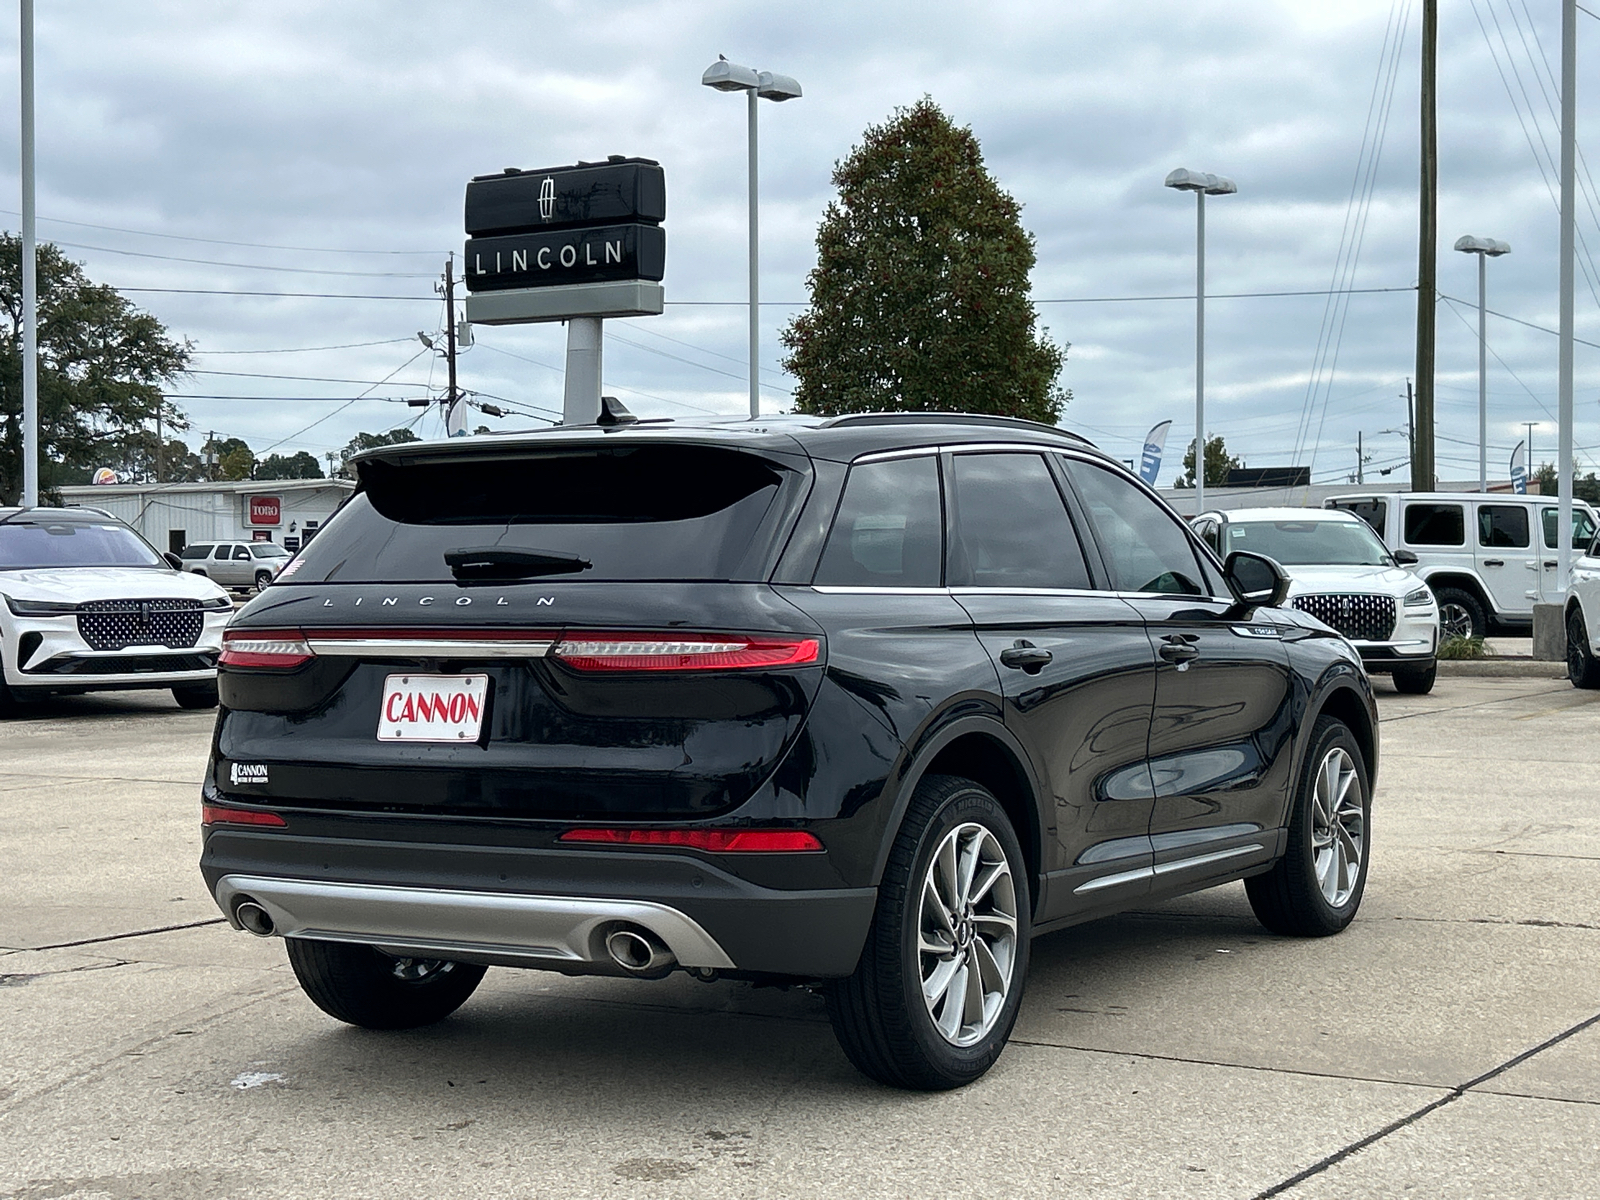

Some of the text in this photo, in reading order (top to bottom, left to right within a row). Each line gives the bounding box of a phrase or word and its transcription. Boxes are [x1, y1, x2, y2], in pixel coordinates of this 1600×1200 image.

[475, 240, 621, 275] LINCOLN
[252, 505, 278, 516] TORO
[323, 597, 555, 607] LINCOLN
[386, 692, 482, 724] CANNON
[237, 764, 268, 776] CANNON
